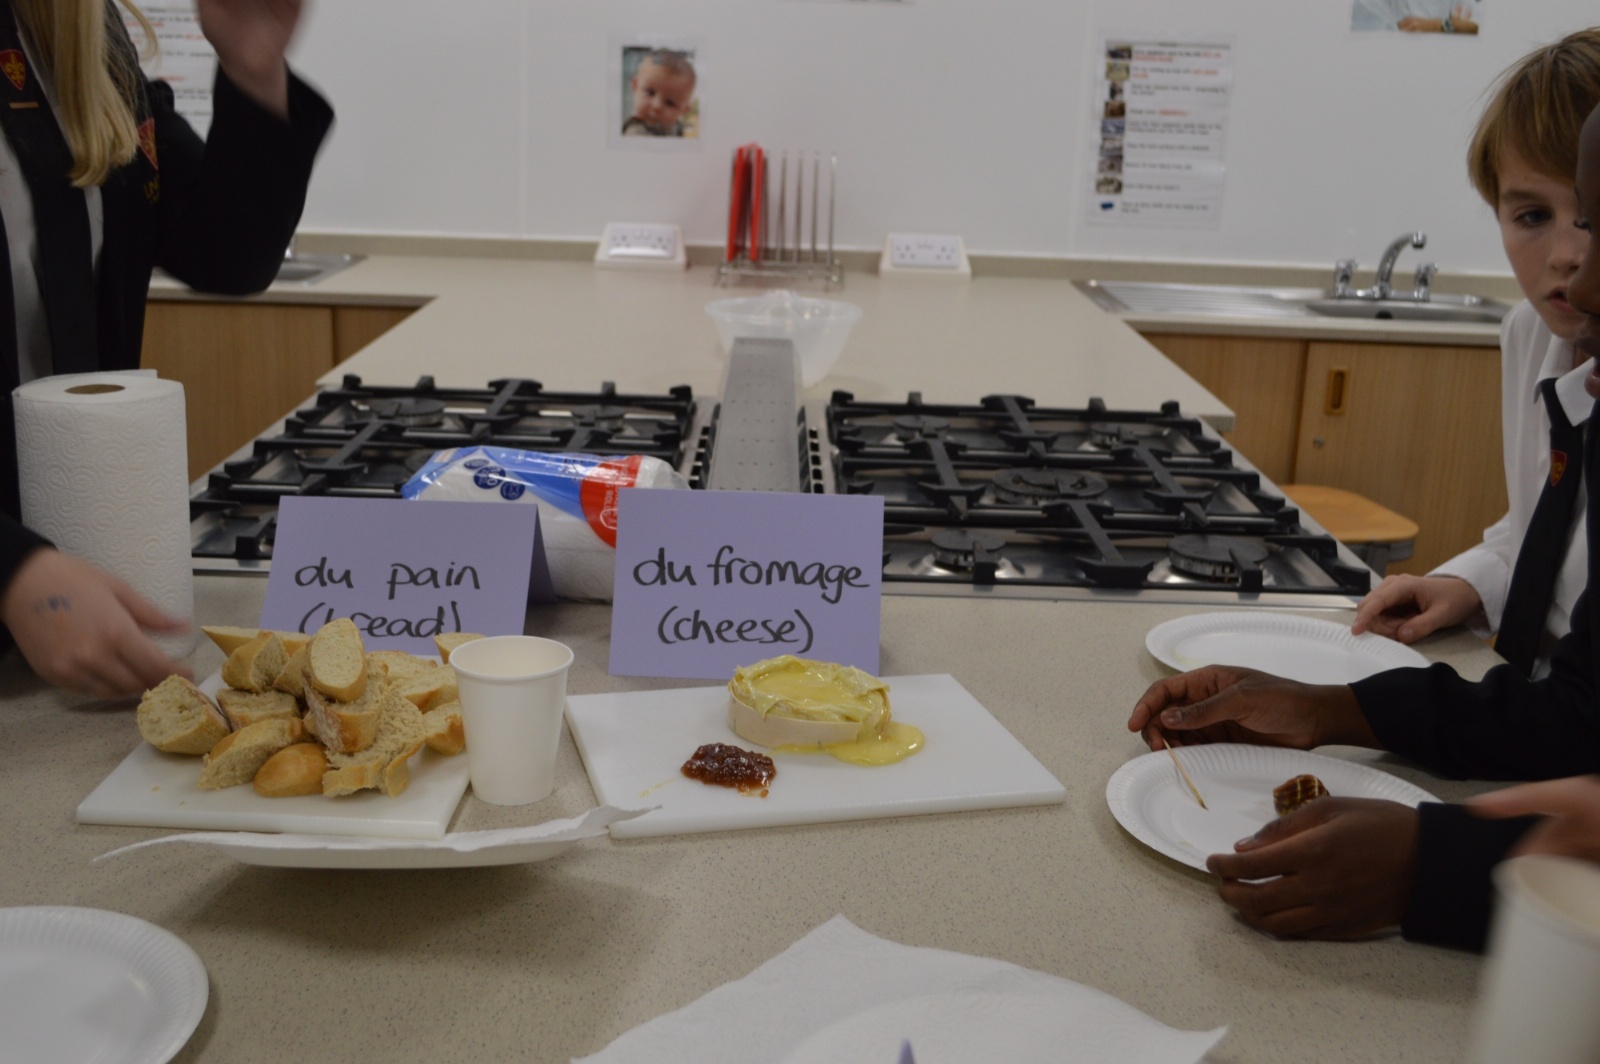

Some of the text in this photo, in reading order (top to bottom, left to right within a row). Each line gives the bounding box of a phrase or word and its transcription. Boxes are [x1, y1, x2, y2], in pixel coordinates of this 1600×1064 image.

[294, 557, 480, 600] du pain
[633, 545, 870, 604] du fromage
[657, 606, 814, 654] (cheese)
